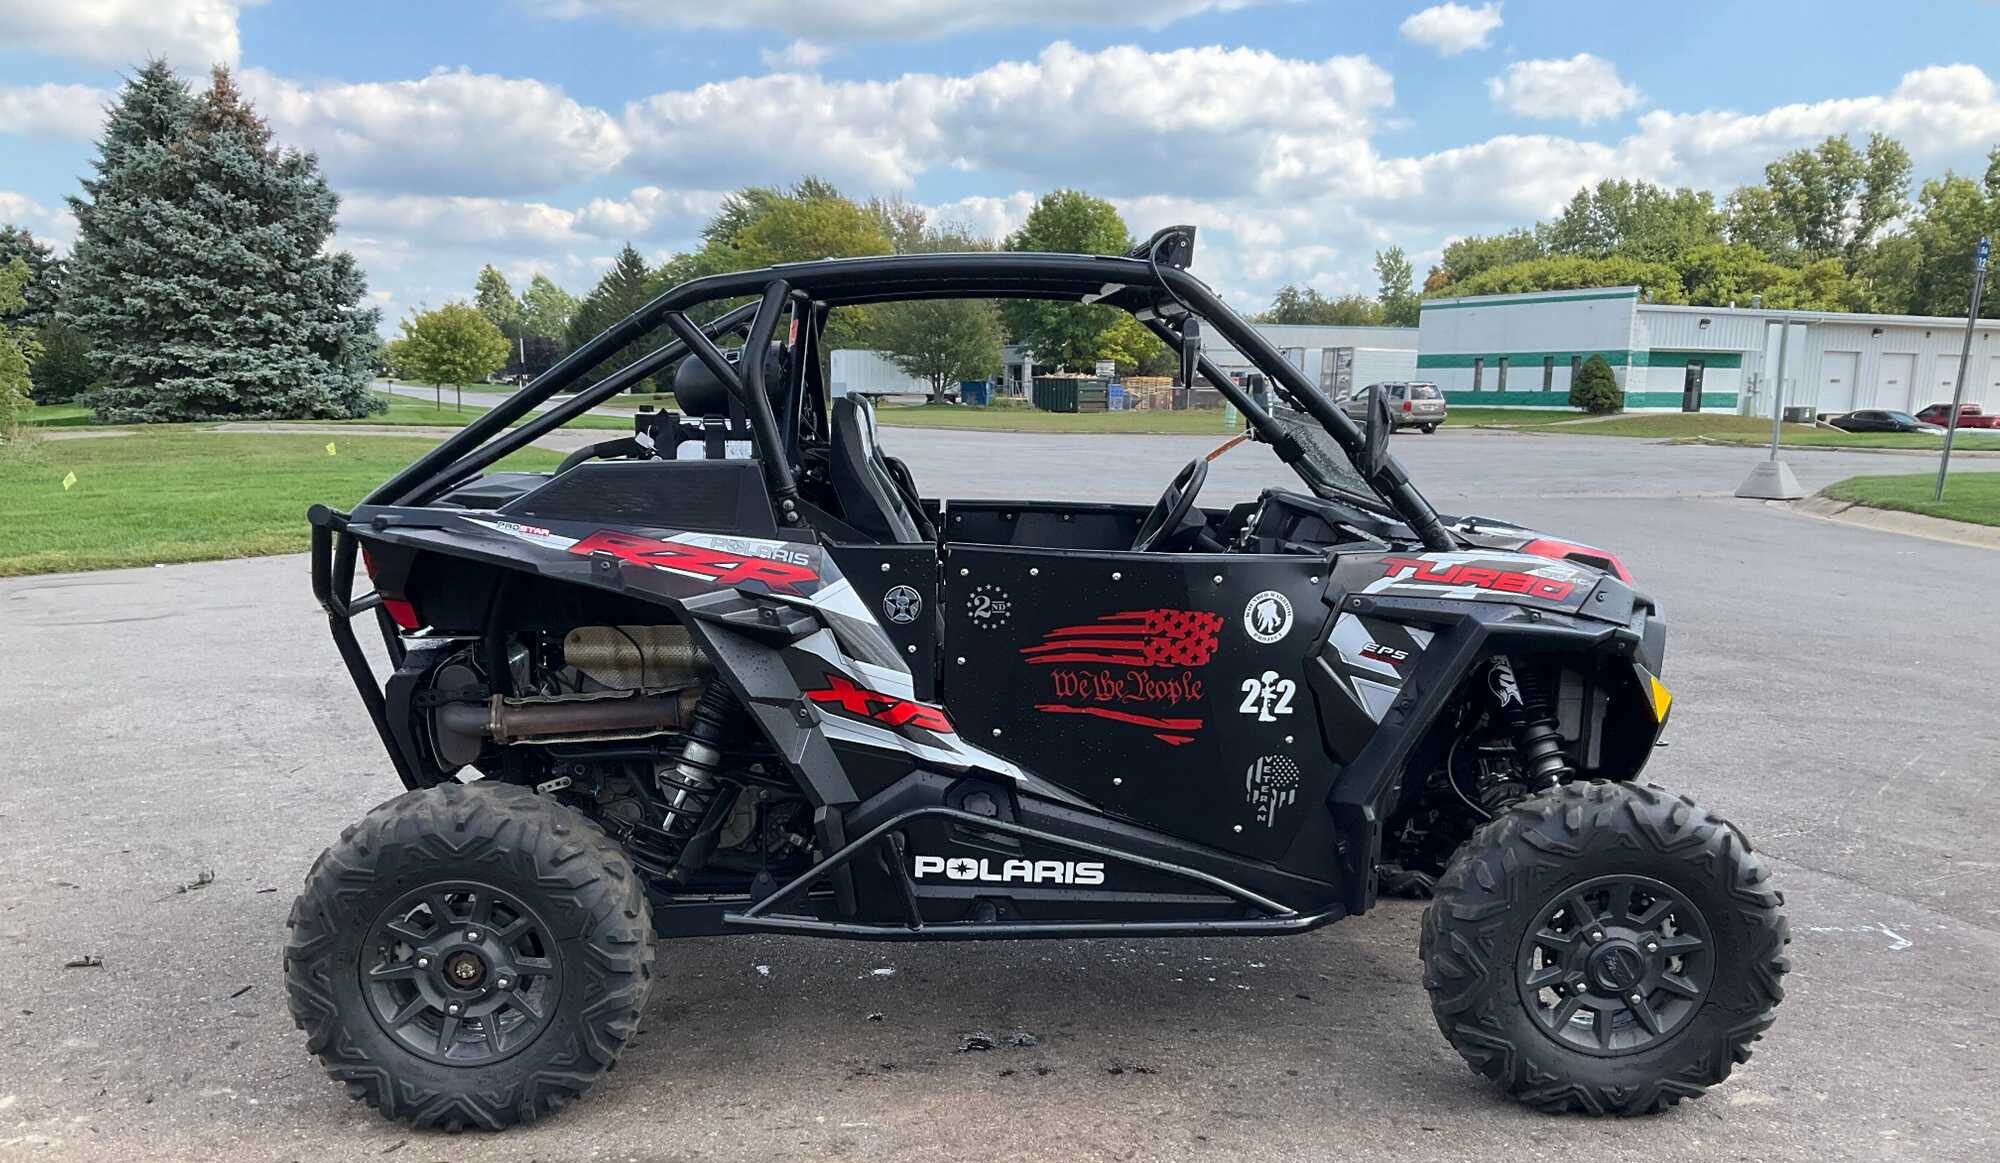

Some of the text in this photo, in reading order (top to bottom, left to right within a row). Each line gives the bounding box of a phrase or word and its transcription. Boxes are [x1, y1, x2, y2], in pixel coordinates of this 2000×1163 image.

[570, 532, 820, 596] RZR
[710, 537, 809, 566] POLARIS
[1380, 557, 1576, 601] TURBO
[1362, 643, 1409, 660] EPS
[1051, 669, 1092, 700] We
[1124, 670, 1206, 707] People
[1256, 755, 1274, 823] VETERAN
[914, 855, 1106, 885] POLARIS
